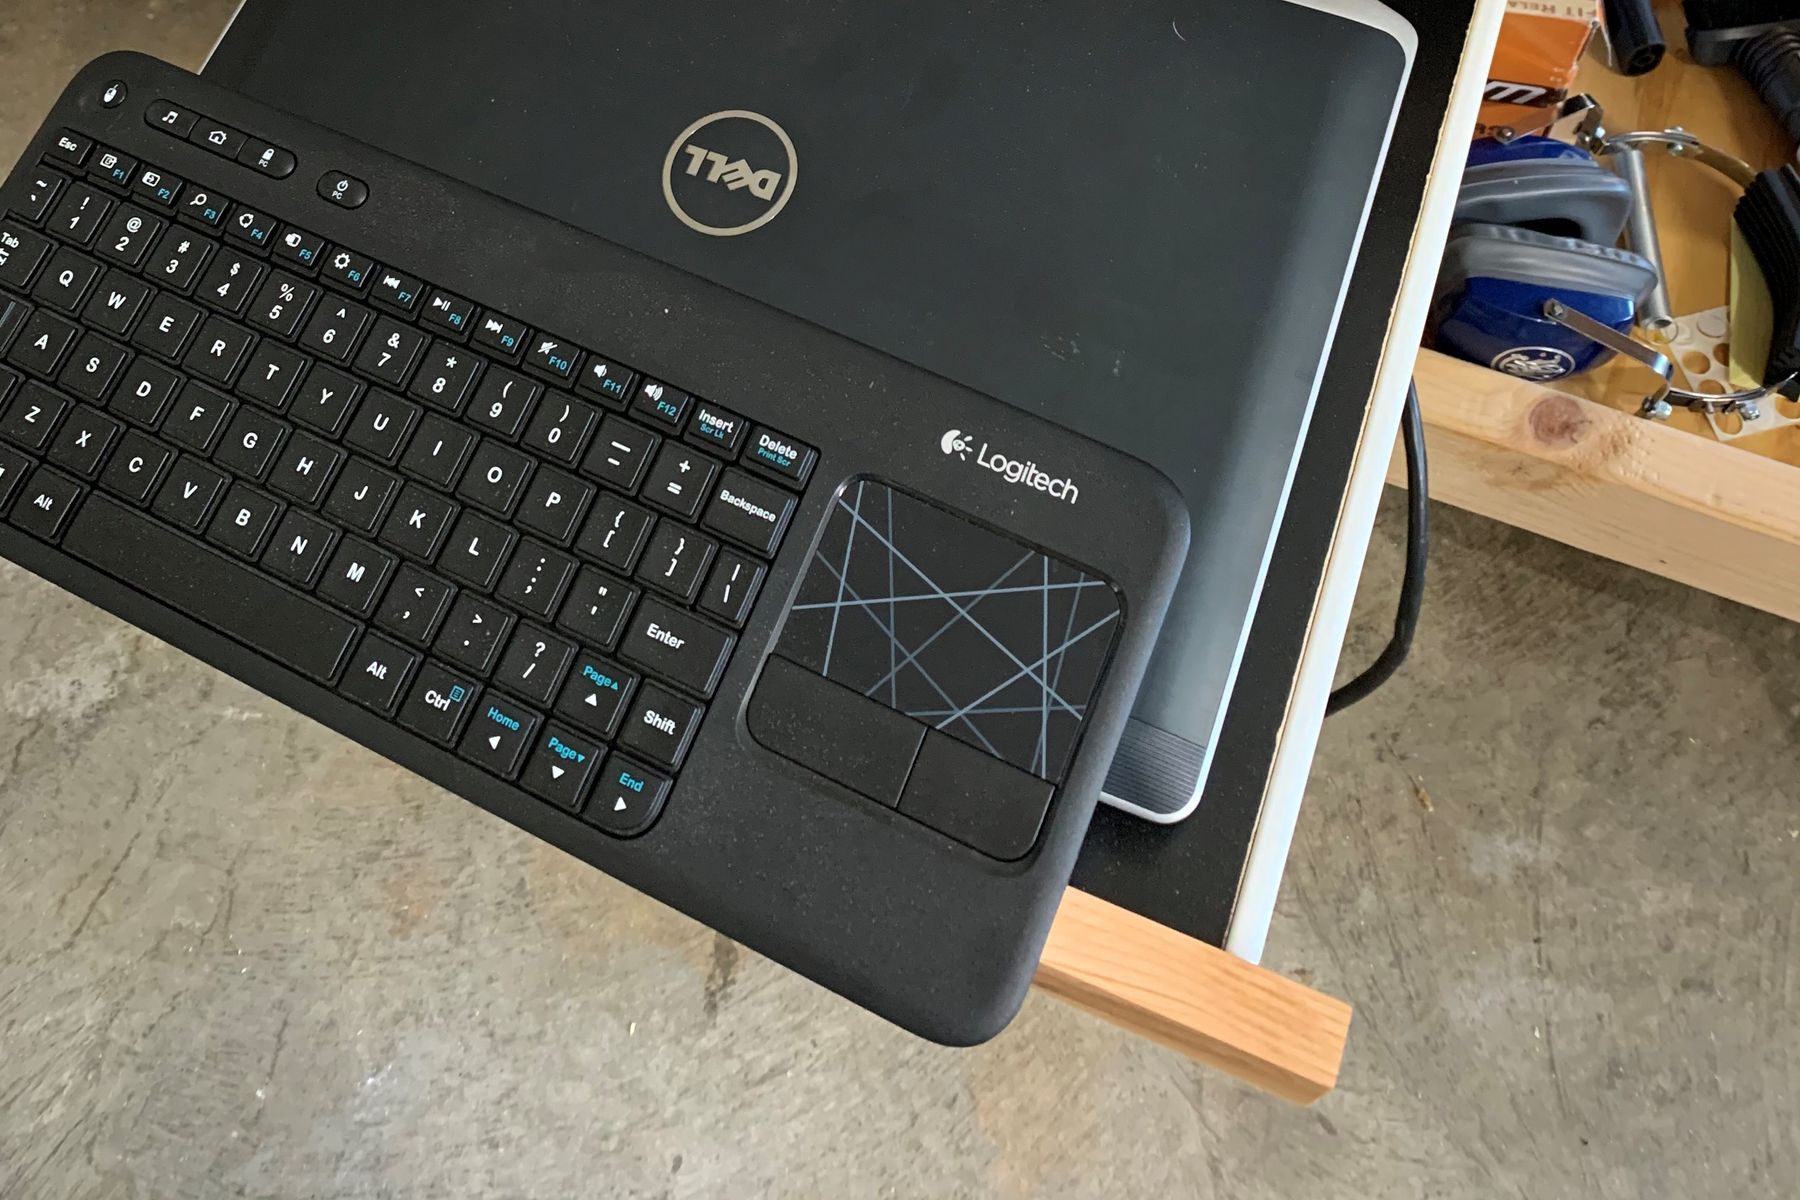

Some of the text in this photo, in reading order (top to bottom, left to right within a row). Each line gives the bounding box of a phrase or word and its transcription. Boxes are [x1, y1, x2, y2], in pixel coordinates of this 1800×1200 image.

[59, 137, 77, 151] Esc
[259, 157, 270, 167] PC
[112, 168, 125, 181] F1
[685, 144, 782, 201] DELL
[158, 188, 172, 201] F2
[332, 189, 344, 199] PC
[70, 217, 79, 229] 1
[204, 209, 219, 222] F3
[1, 232, 18, 249] Tab
[251, 229, 265, 242] F4
[115, 237, 129, 251] 2
[299, 249, 314, 262] F5
[166, 260, 178, 273] 3
[59, 270, 73, 287] Q
[348, 270, 362, 283] F6
[217, 283, 230, 296] 4
[398, 290, 412, 303] F7
[108, 292, 126, 309] W
[269, 305, 283, 319] 5
[159, 316, 174, 332] E
[449, 314, 463, 326] F8
[34, 334, 48, 349] A
[323, 329, 336, 343] 6
[501, 336, 514, 347] F9
[211, 340, 226, 356] R
[86, 357, 99, 372] S
[378, 352, 391, 366] 7
[549, 356, 569, 371] F10
[267, 364, 279, 380] T
[136, 381, 151, 397] D
[432, 378, 446, 393] 8
[603, 379, 622, 393] F11
[320, 388, 333, 404] Y
[25, 406, 41, 422] Z
[190, 406, 204, 420] F
[490, 402, 502, 417] 9
[657, 402, 676, 417] F12
[374, 414, 389, 431] U
[699, 408, 734, 433] Insert
[76, 430, 91, 447] X
[243, 433, 258, 448] G
[548, 428, 561, 443] 0
[757, 447, 777, 461] Print
[758, 434, 798, 459] Delete
[129, 457, 143, 472] C
[296, 457, 313, 475] H
[487, 467, 502, 483] O
[976, 443, 1079, 504] Logitech
[184, 482, 198, 498] V
[354, 486, 368, 500] J
[34, 495, 52, 510] Alt
[546, 492, 561, 507] P
[720, 490, 777, 522] Backspace
[235, 509, 251, 526] B
[409, 510, 426, 528] K
[291, 536, 307, 554] N
[469, 537, 480, 556] L
[347, 562, 365, 582] M
[647, 623, 684, 648] Enter
[366, 661, 387, 679] Alt
[583, 666, 613, 688] Page
[424, 689, 452, 712] Ctrl
[488, 707, 519, 730] Home
[644, 710, 675, 735] Shift
[548, 737, 577, 759] Page
[619, 773, 644, 792] End
